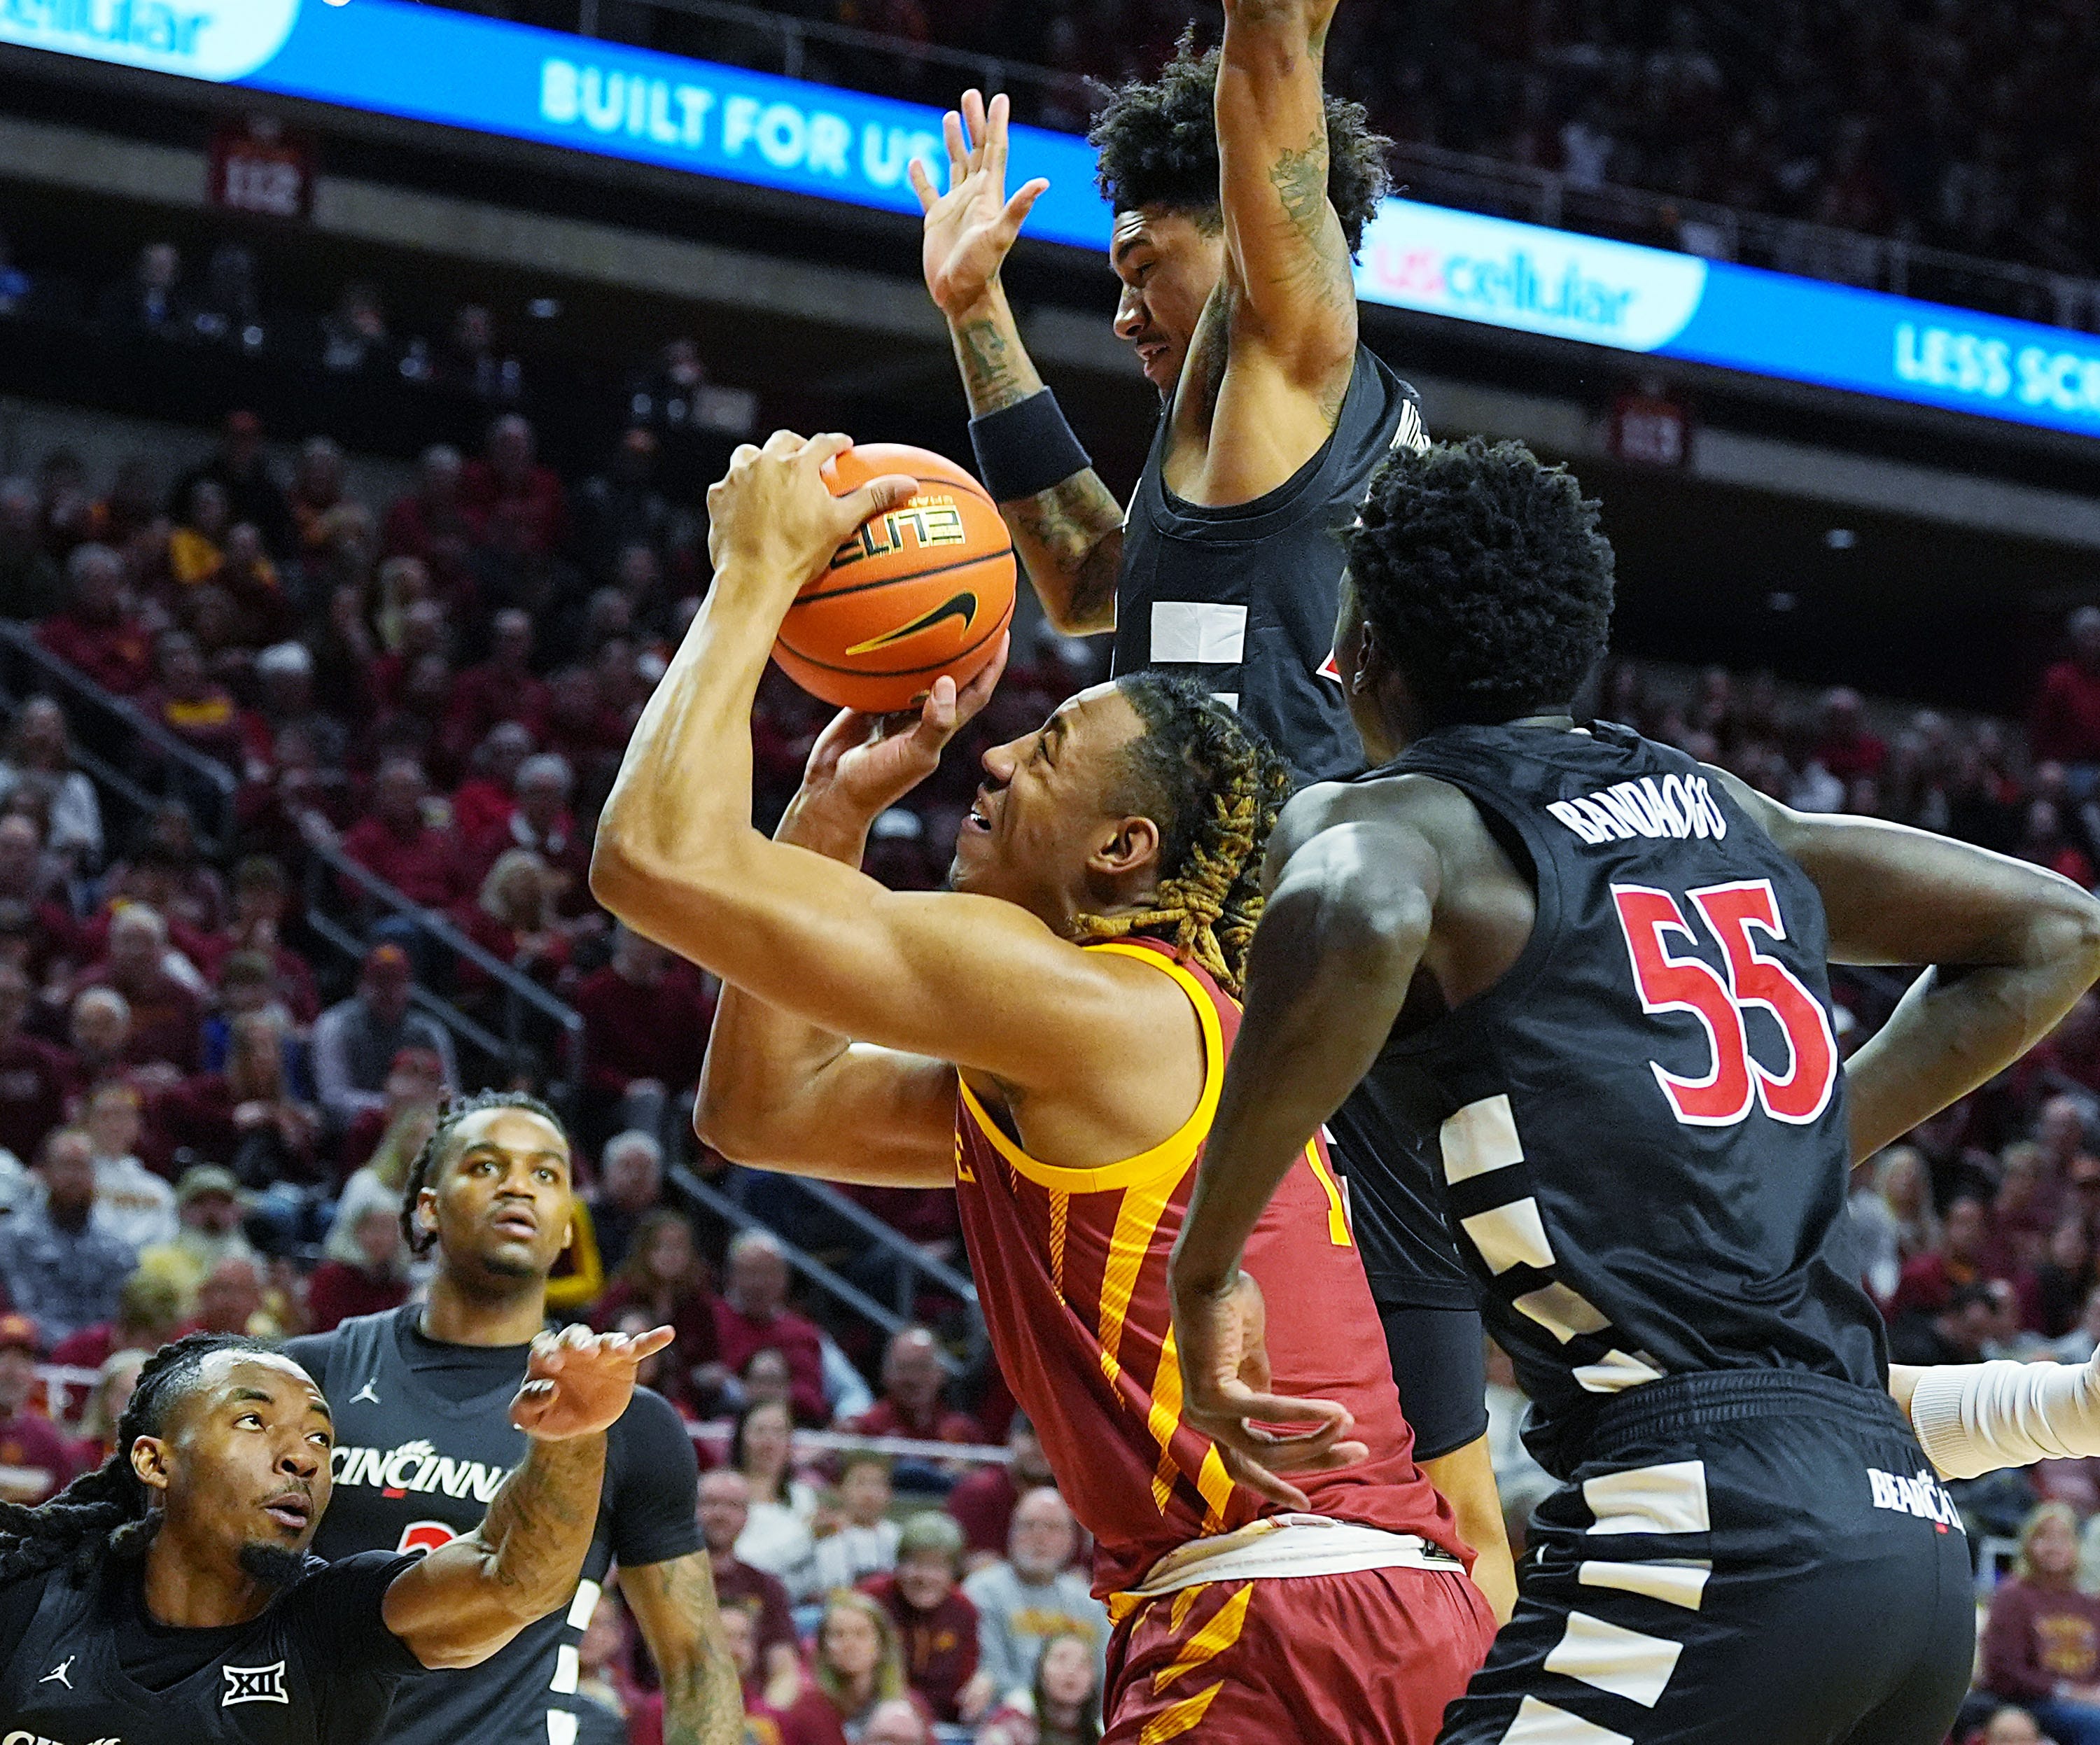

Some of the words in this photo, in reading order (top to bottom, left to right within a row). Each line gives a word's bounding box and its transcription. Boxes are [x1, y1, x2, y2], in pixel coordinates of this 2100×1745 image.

[540, 59, 715, 151] BUILT
[722, 96, 849, 180] FOR
[860, 121, 944, 192] US
[1893, 323, 2011, 398] LESS
[1546, 773, 1728, 845] BANDAOGO
[1610, 878, 1839, 1127] 55
[227, 1669, 284, 1700] XII
